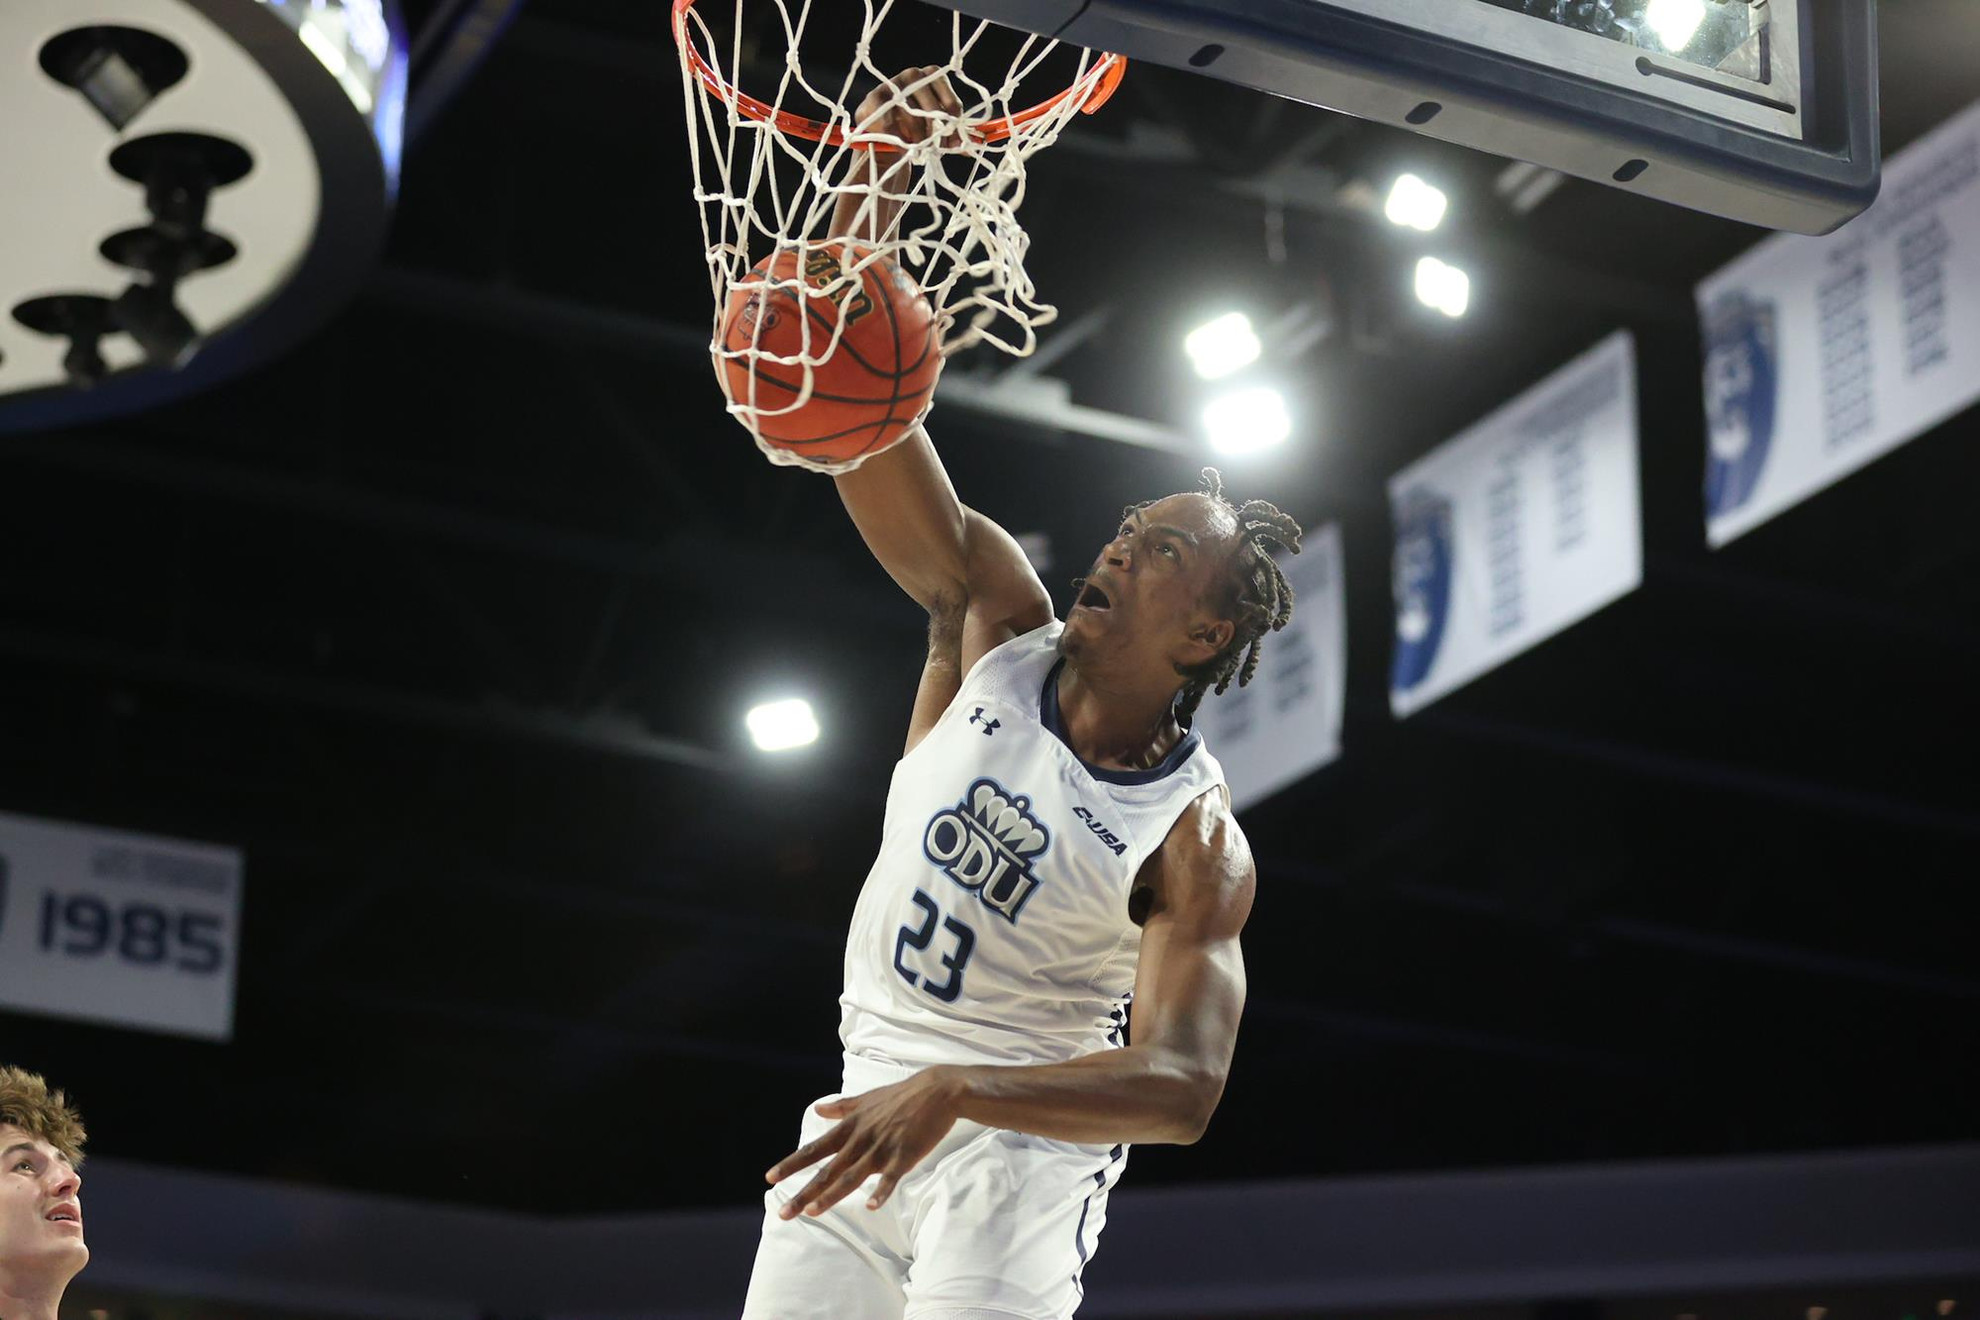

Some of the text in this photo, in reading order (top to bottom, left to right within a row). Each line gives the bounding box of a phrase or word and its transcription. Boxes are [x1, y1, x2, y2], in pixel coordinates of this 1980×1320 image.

[925, 810, 1040, 926] ODU
[1072, 806, 1128, 857] C-USA
[41, 889, 223, 977] 1985
[894, 888, 975, 1003] 23
